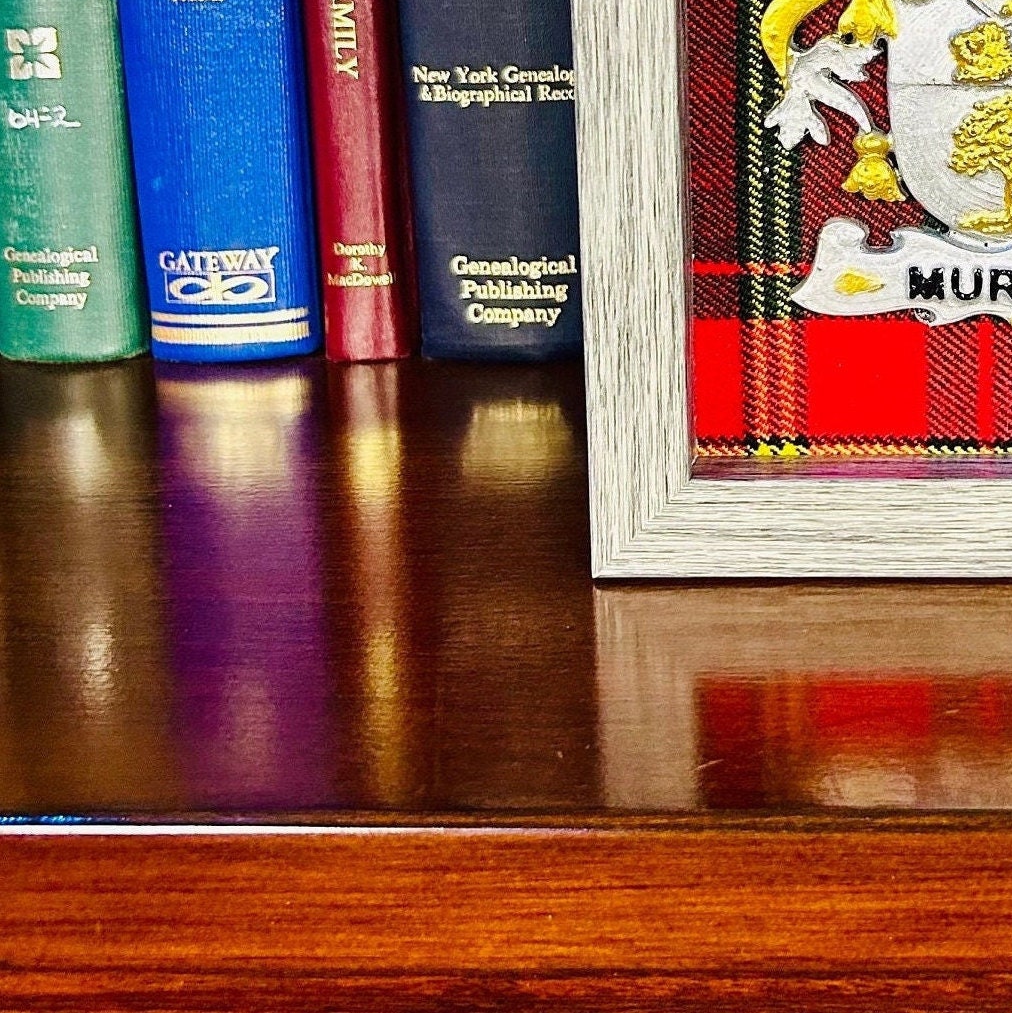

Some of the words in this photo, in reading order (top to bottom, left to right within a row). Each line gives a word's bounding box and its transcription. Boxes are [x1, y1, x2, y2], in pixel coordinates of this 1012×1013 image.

[412, 64, 451, 84] New
[454, 65, 499, 84] York
[4, 245, 98, 268] Genealogical
[158, 246, 280, 272] GATEWAY
[333, 241, 386, 258] Dorothy
[12, 267, 91, 288] Publishing
[451, 253, 578, 279] Genealogical
[16, 288, 88, 311] Company
[460, 278, 569, 303] Publishing
[467, 302, 562, 330] Company
